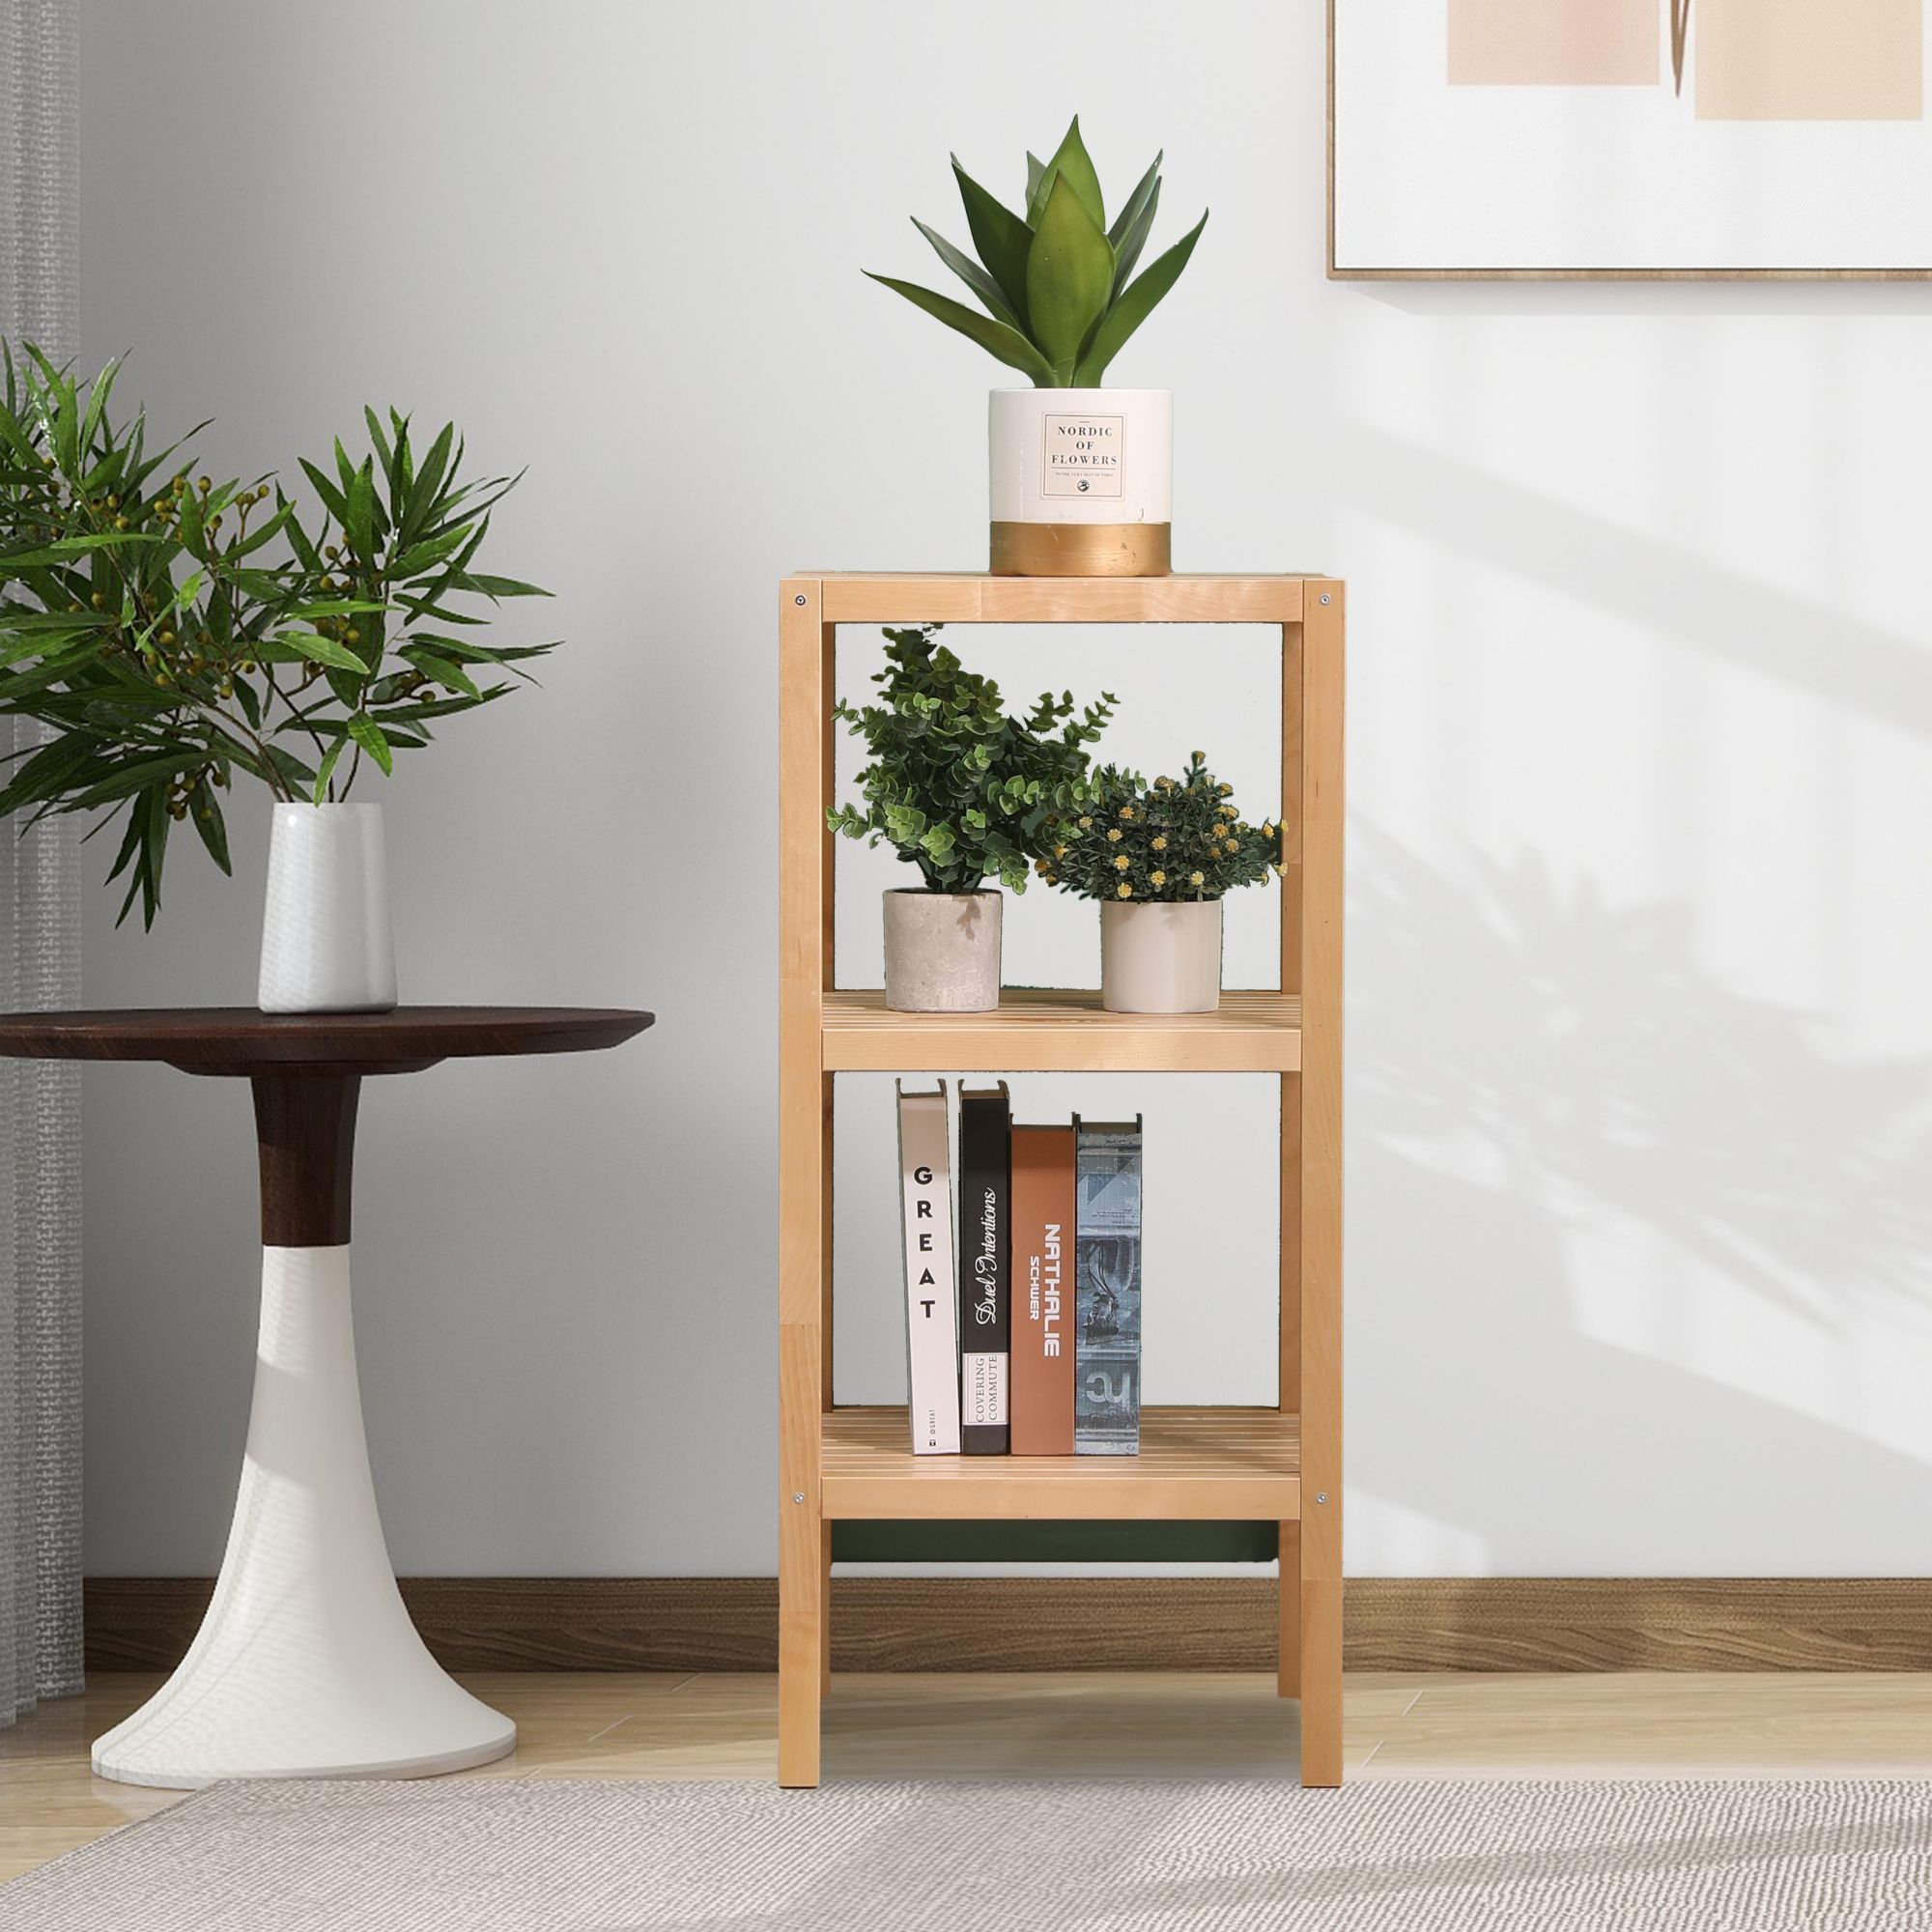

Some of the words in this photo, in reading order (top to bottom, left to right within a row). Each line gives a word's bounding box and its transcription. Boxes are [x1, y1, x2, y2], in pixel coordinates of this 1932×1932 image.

[1051, 454, 1118, 465] FLOWERS
[1058, 426, 1113, 437] NORDIC
[1075, 440, 1094, 450] OF
[913, 1166, 936, 1319] GREAT
[975, 1187, 997, 1273] Intentions
[974, 1273, 997, 1324] Duel
[1030, 1255, 1040, 1321] SCHWER
[1043, 1223, 1062, 1357] NATHALIE
[975, 1357, 984, 1423] COVERING
[988, 1355, 998, 1421] COMMUTE
